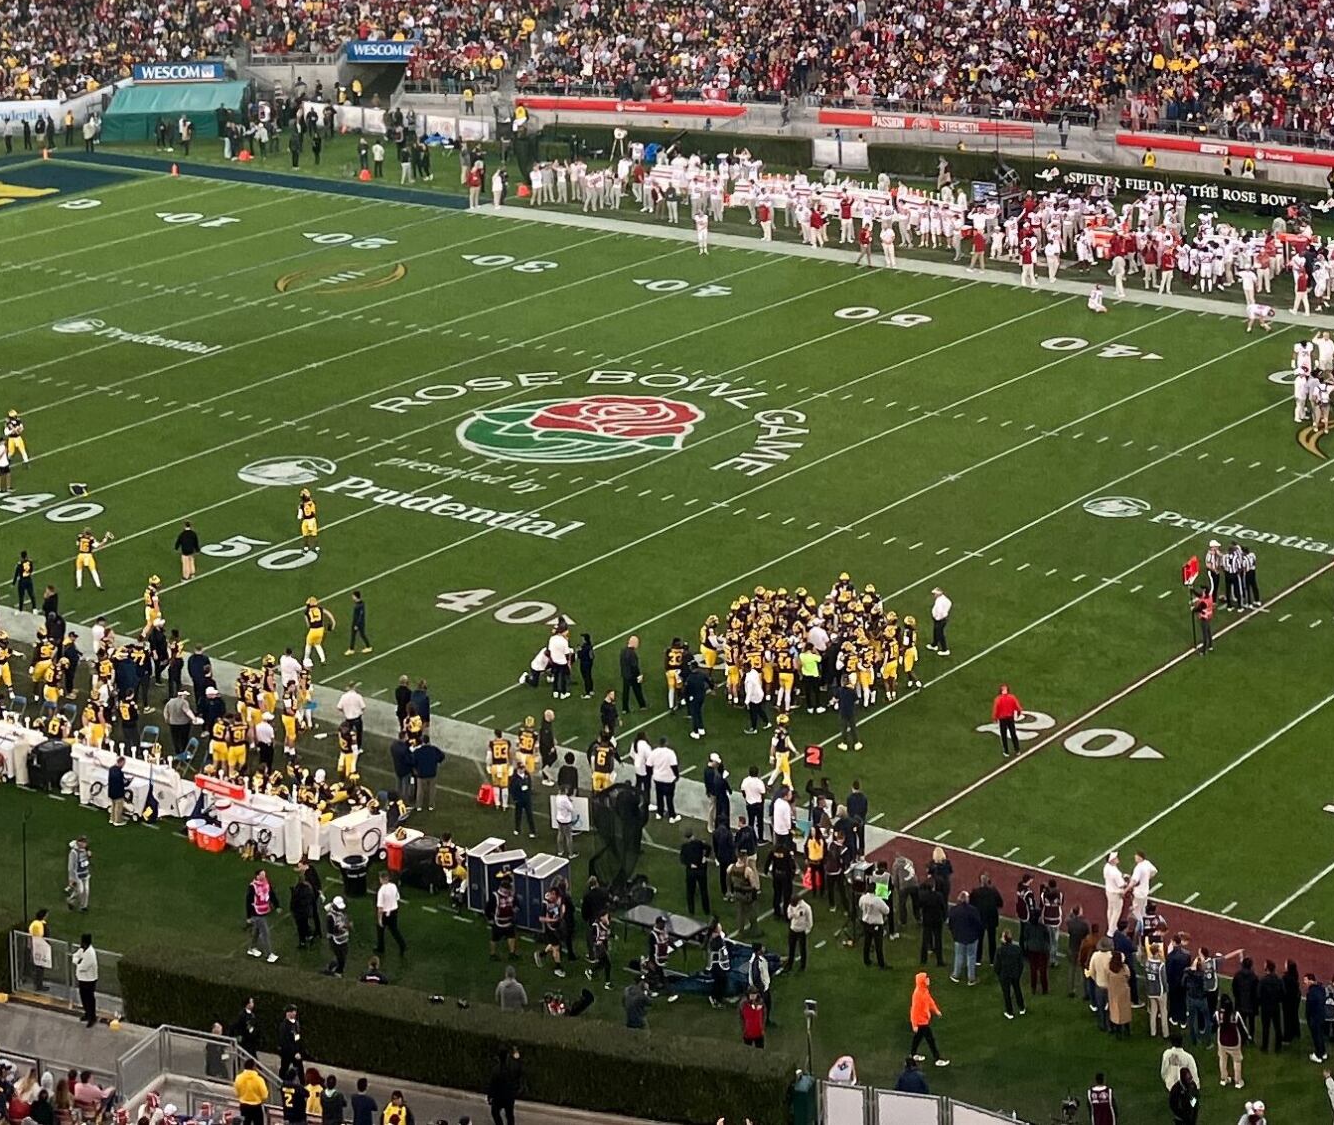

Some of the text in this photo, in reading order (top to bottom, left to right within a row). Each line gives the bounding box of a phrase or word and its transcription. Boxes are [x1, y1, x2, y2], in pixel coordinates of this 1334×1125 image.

[353, 43, 402, 57] WESCOM
[141, 65, 201, 80] WESCOM
[872, 115, 906, 129] PASSION
[1125, 178, 1164, 193] FIELD
[1190, 184, 1219, 199] THE
[1222, 189, 1256, 204] ROSE
[834, 307, 933, 327] 50
[94, 326, 225, 355] Prudential
[370, 369, 812, 477] ROSE BOWL GAME
[375, 456, 548, 494] presented by
[319, 476, 586, 539] Prudential
[199, 534, 319, 571] 50
[434, 588, 558, 625] 40
[492, 744, 509, 760] 83
[806, 746, 820, 765] 2
